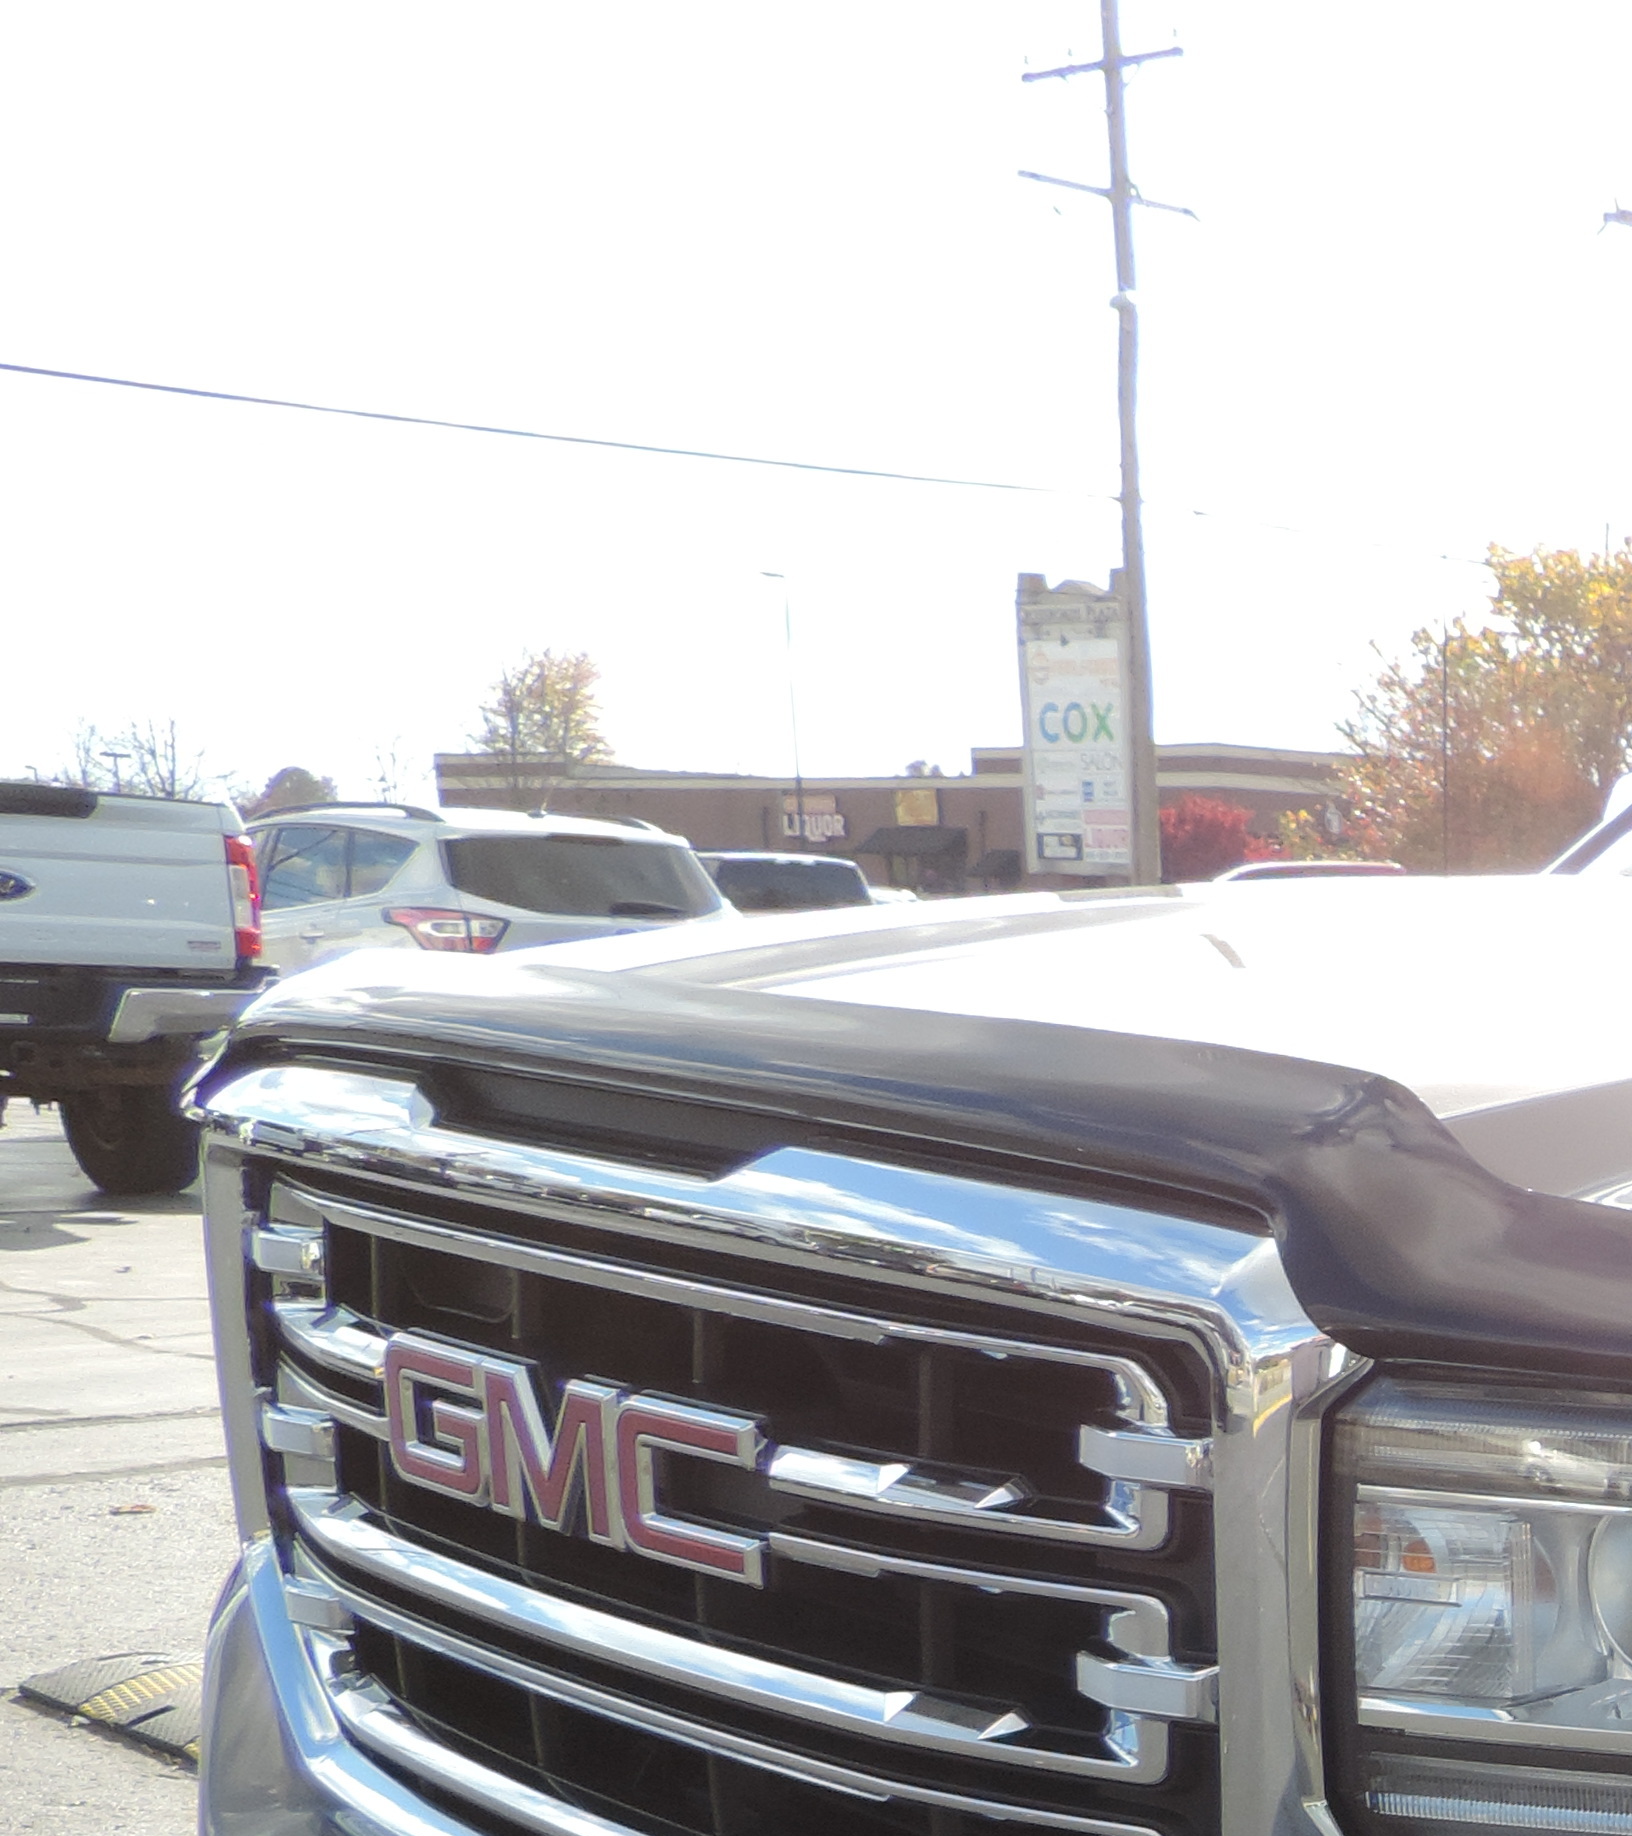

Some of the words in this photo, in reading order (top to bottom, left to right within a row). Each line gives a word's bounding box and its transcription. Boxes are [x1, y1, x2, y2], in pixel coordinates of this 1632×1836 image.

[1038, 701, 1115, 743] COX
[783, 813, 846, 842] LIQUOR
[386, 1332, 762, 1590] GMC
